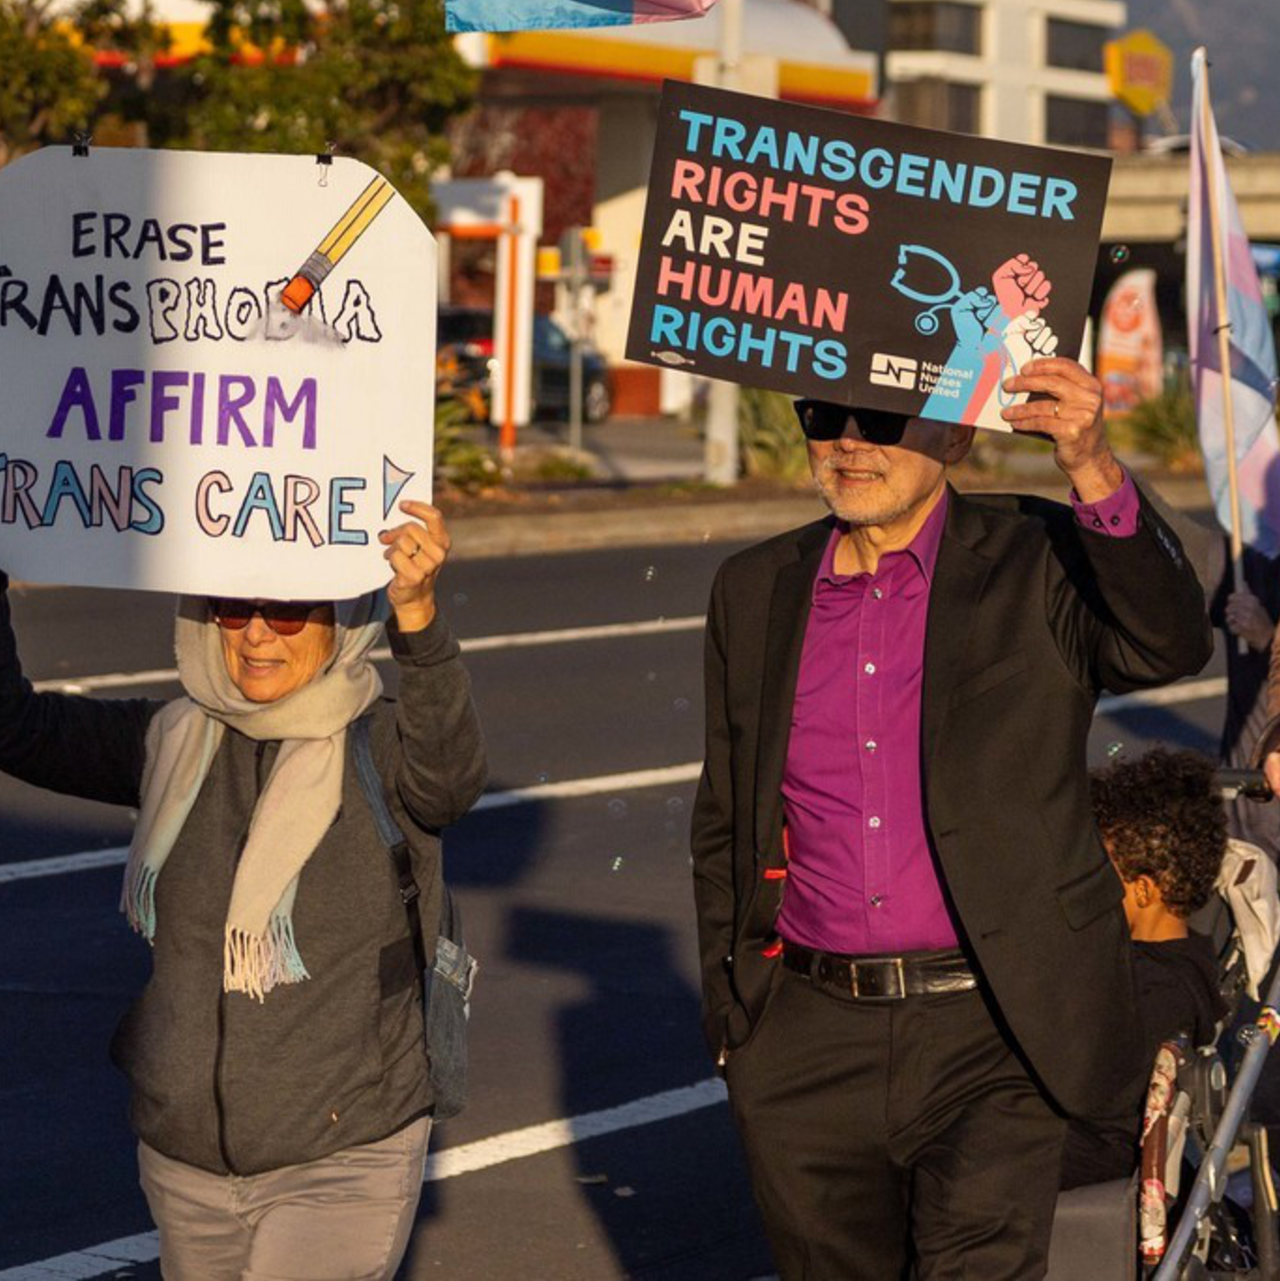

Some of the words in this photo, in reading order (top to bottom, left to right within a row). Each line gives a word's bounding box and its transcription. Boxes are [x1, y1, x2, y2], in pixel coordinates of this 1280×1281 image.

[670, 158, 870, 235] RIGHTS
[679, 109, 1078, 220] TRANSGENDER
[71, 212, 226, 266] ERASE
[661, 208, 770, 267] ARE
[656, 255, 849, 333] HUMAN
[650, 303, 848, 380] RIGHTS
[922, 361, 974, 380] National
[46, 367, 318, 450] AFFIRM
[918, 383, 960, 399] United
[920, 372, 962, 388] Nurses
